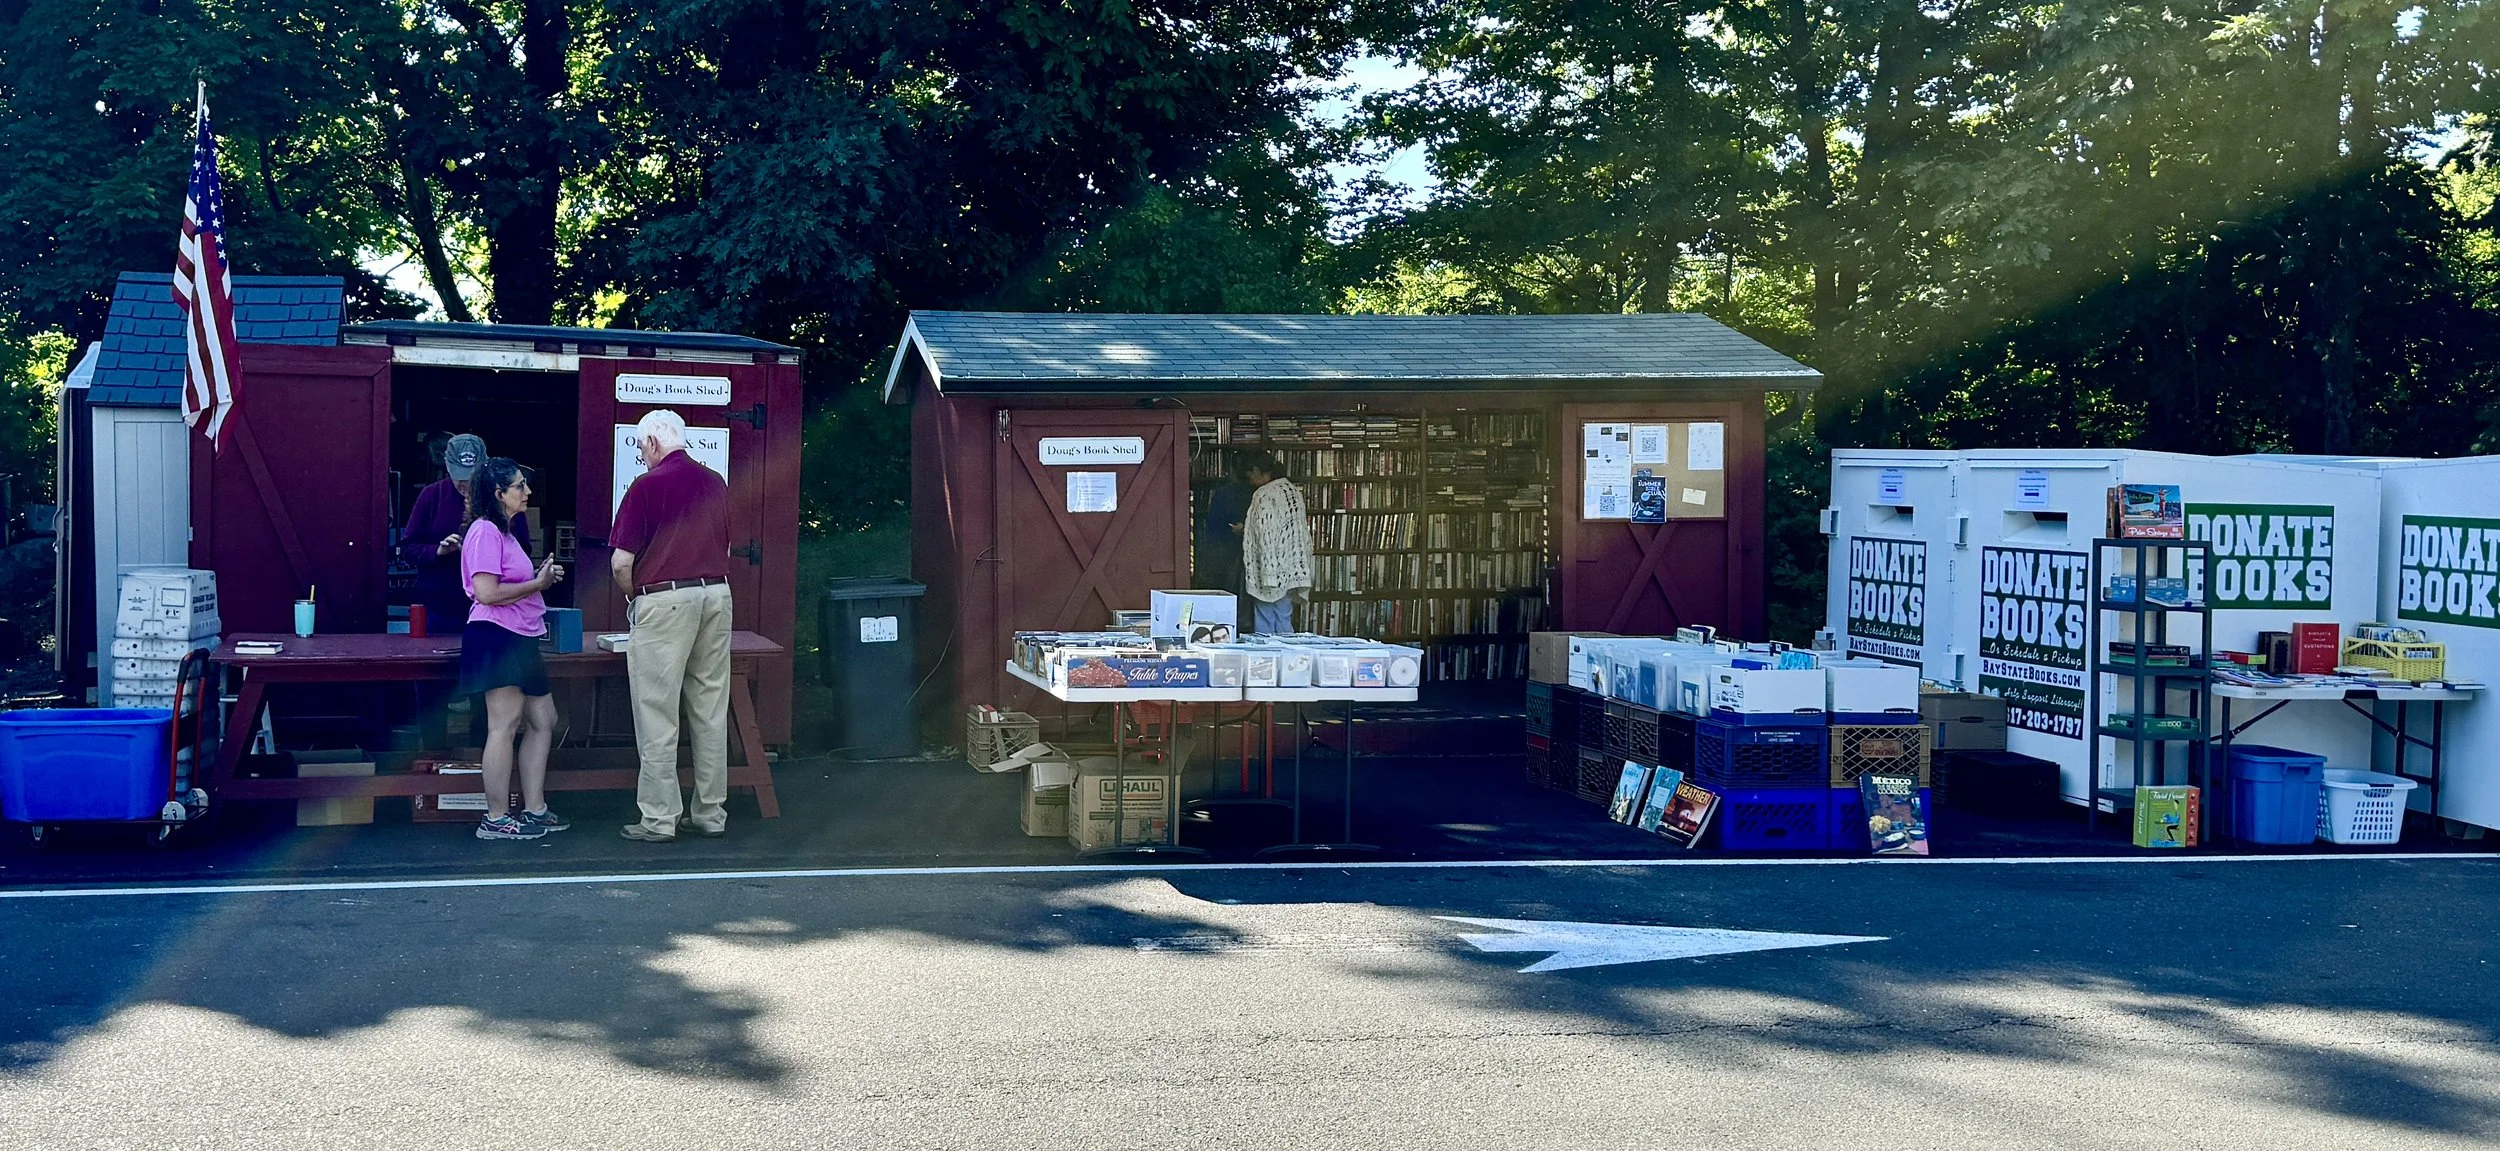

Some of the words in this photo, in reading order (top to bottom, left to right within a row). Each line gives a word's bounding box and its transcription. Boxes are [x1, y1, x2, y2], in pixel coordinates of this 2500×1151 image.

[625, 382, 661, 395] Doug's
[665, 384, 693, 394] Book
[696, 385, 723, 396] Shed
[698, 438, 718, 450] Sat
[1048, 445, 1081, 456] Doug's
[1084, 445, 1110, 455] Book
[1112, 445, 1137, 454] Shed
[2188, 514, 2332, 557] DONATE
[2402, 524, 2500, 573] DONAT
[1852, 539, 1925, 585] DONATE
[1984, 550, 2086, 602] DONATE
[2188, 559, 2331, 600] BOOKS
[2400, 568, 2500, 619] BOOK
[1850, 580, 1923, 627] BOOKS
[1864, 623, 1891, 637] Schedule
[1899, 628, 1921, 644] Pickup
[1982, 595, 2084, 650] BOOKS
[2003, 644, 2040, 660] Schedule
[2043, 653, 2048, 661] a
[2052, 650, 2082, 669] Pickup
[1128, 667, 1158, 681] Table
[1162, 667, 1199, 684] Grapes
[2004, 688, 2020, 700] Help
[2022, 689, 2048, 705] Support
[1676, 783, 1711, 805] WEATHER
